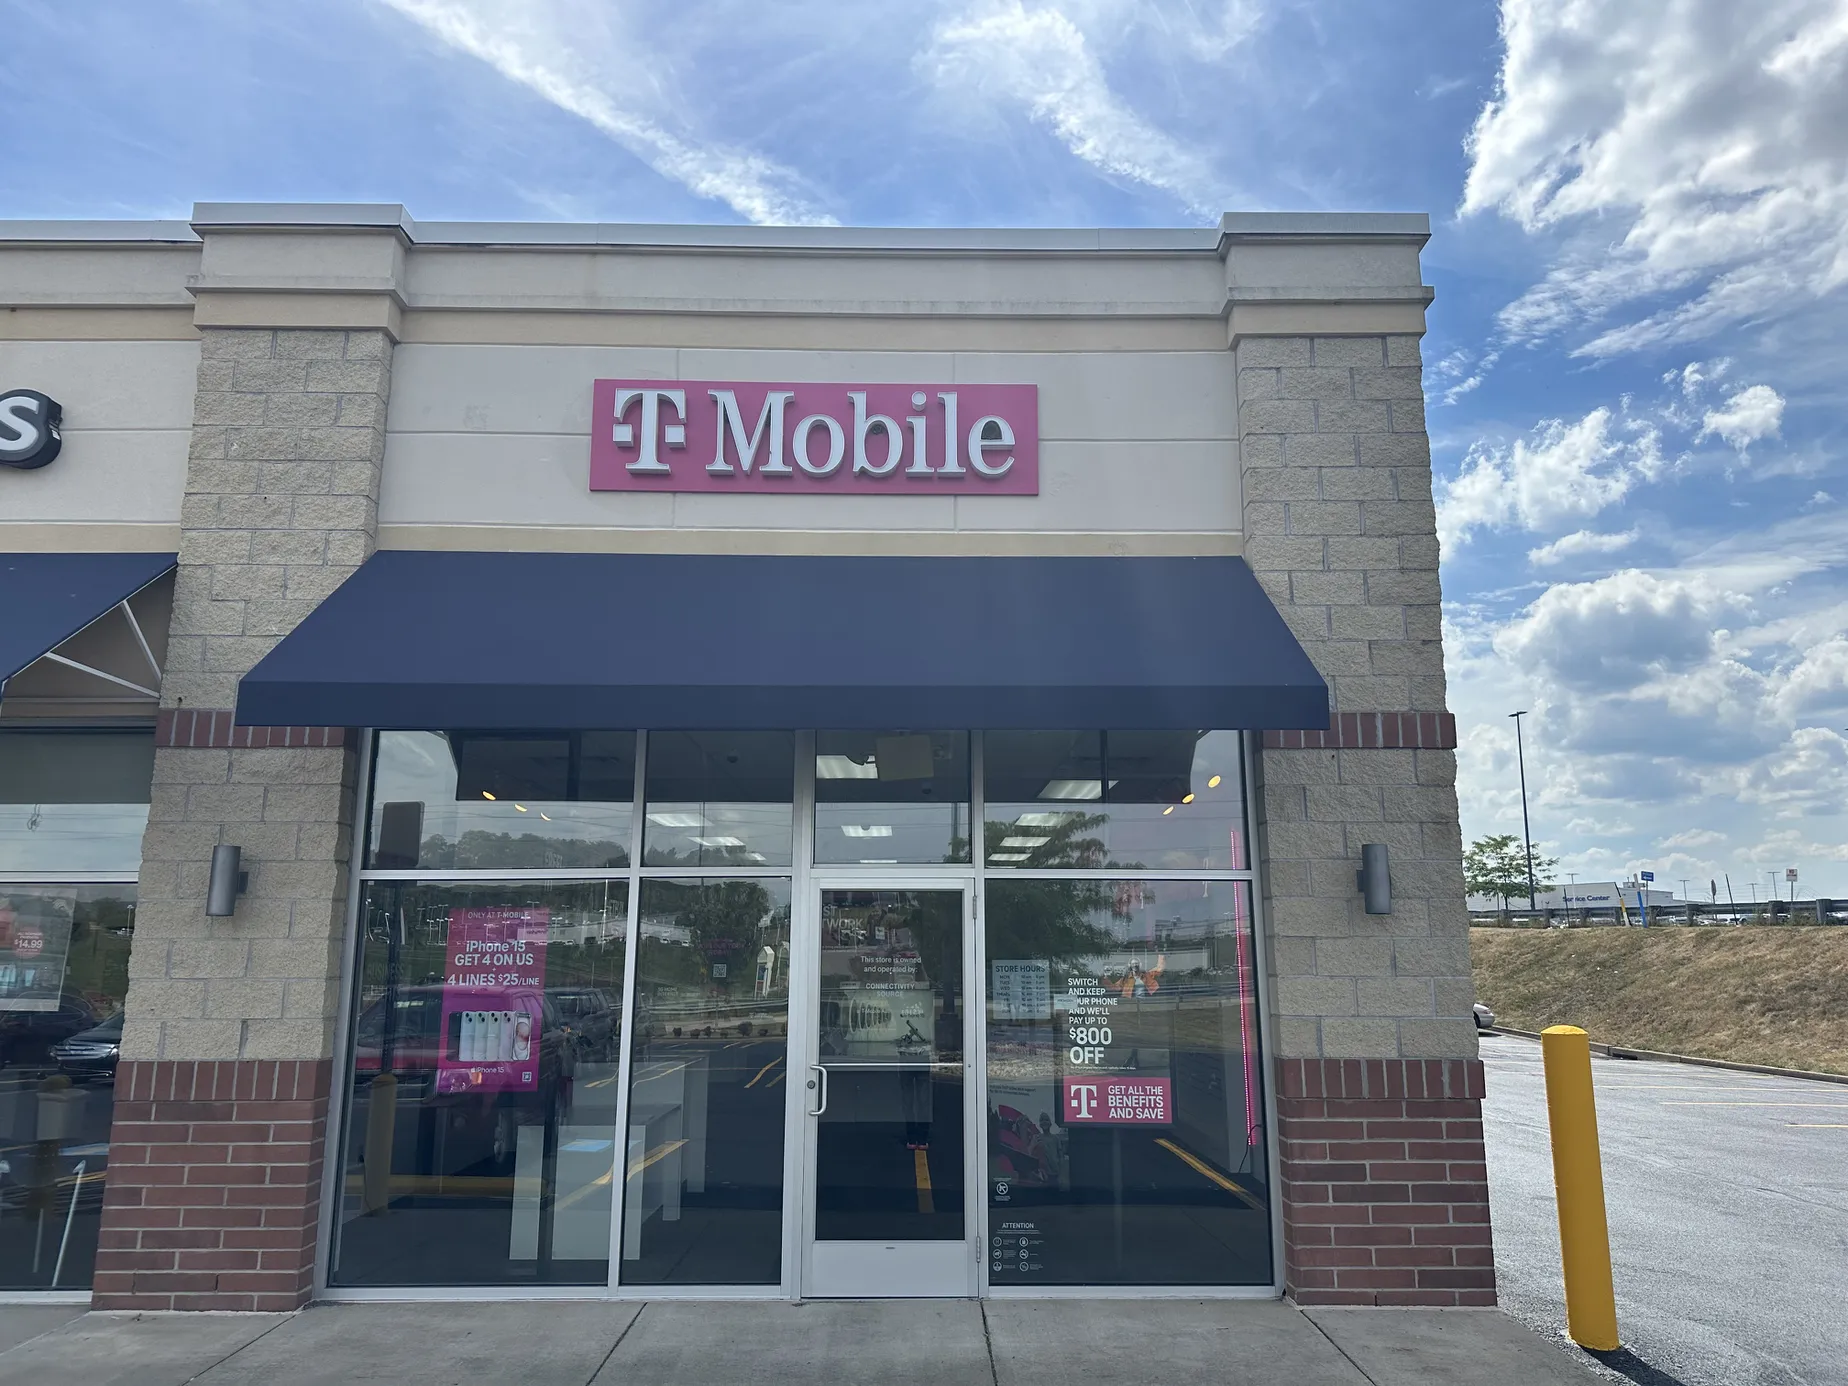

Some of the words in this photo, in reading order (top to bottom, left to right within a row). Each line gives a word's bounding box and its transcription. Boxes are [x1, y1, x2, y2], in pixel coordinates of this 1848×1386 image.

[706, 389, 1015, 478] Mobile
[468, 911, 484, 919] ONLY
[497, 911, 529, 919] T-MOBILE
[14, 939, 43, 949] $14.99
[466, 940, 509, 952] iPhone
[511, 940, 526, 952] 15
[455, 953, 481, 966] GET
[482, 954, 491, 966] 4
[493, 953, 513, 965] ON
[516, 953, 534, 965] US
[860, 955, 875, 963] This
[877, 966, 907, 974] operated
[995, 965, 1019, 973] STORE
[1020, 965, 1046, 973] HOURS
[447, 974, 457, 986] 4
[459, 974, 496, 986] LINES
[1067, 978, 1099, 986] SWITCH
[865, 982, 915, 990] CONNECTIVITY
[1068, 987, 1086, 996] AND
[1086, 987, 1106, 996] KEEP
[1091, 997, 1118, 1006] PHONE
[1069, 1007, 1086, 1015] AND
[1087, 1007, 1110, 1015] WE'LL
[1069, 1016, 1084, 1025] PAY
[1084, 1016, 1096, 1025] UP
[1097, 1016, 1108, 1025] TO
[1069, 1027, 1112, 1045] $800
[1070, 1046, 1105, 1065] OFF
[1107, 1085, 1126, 1095] GET
[1127, 1086, 1145, 1095] ALL
[1145, 1086, 1163, 1095] THE
[1108, 1095, 1164, 1107] BENEFITS
[1109, 1108, 1134, 1119] AND
[1135, 1108, 1164, 1119] SAVE
